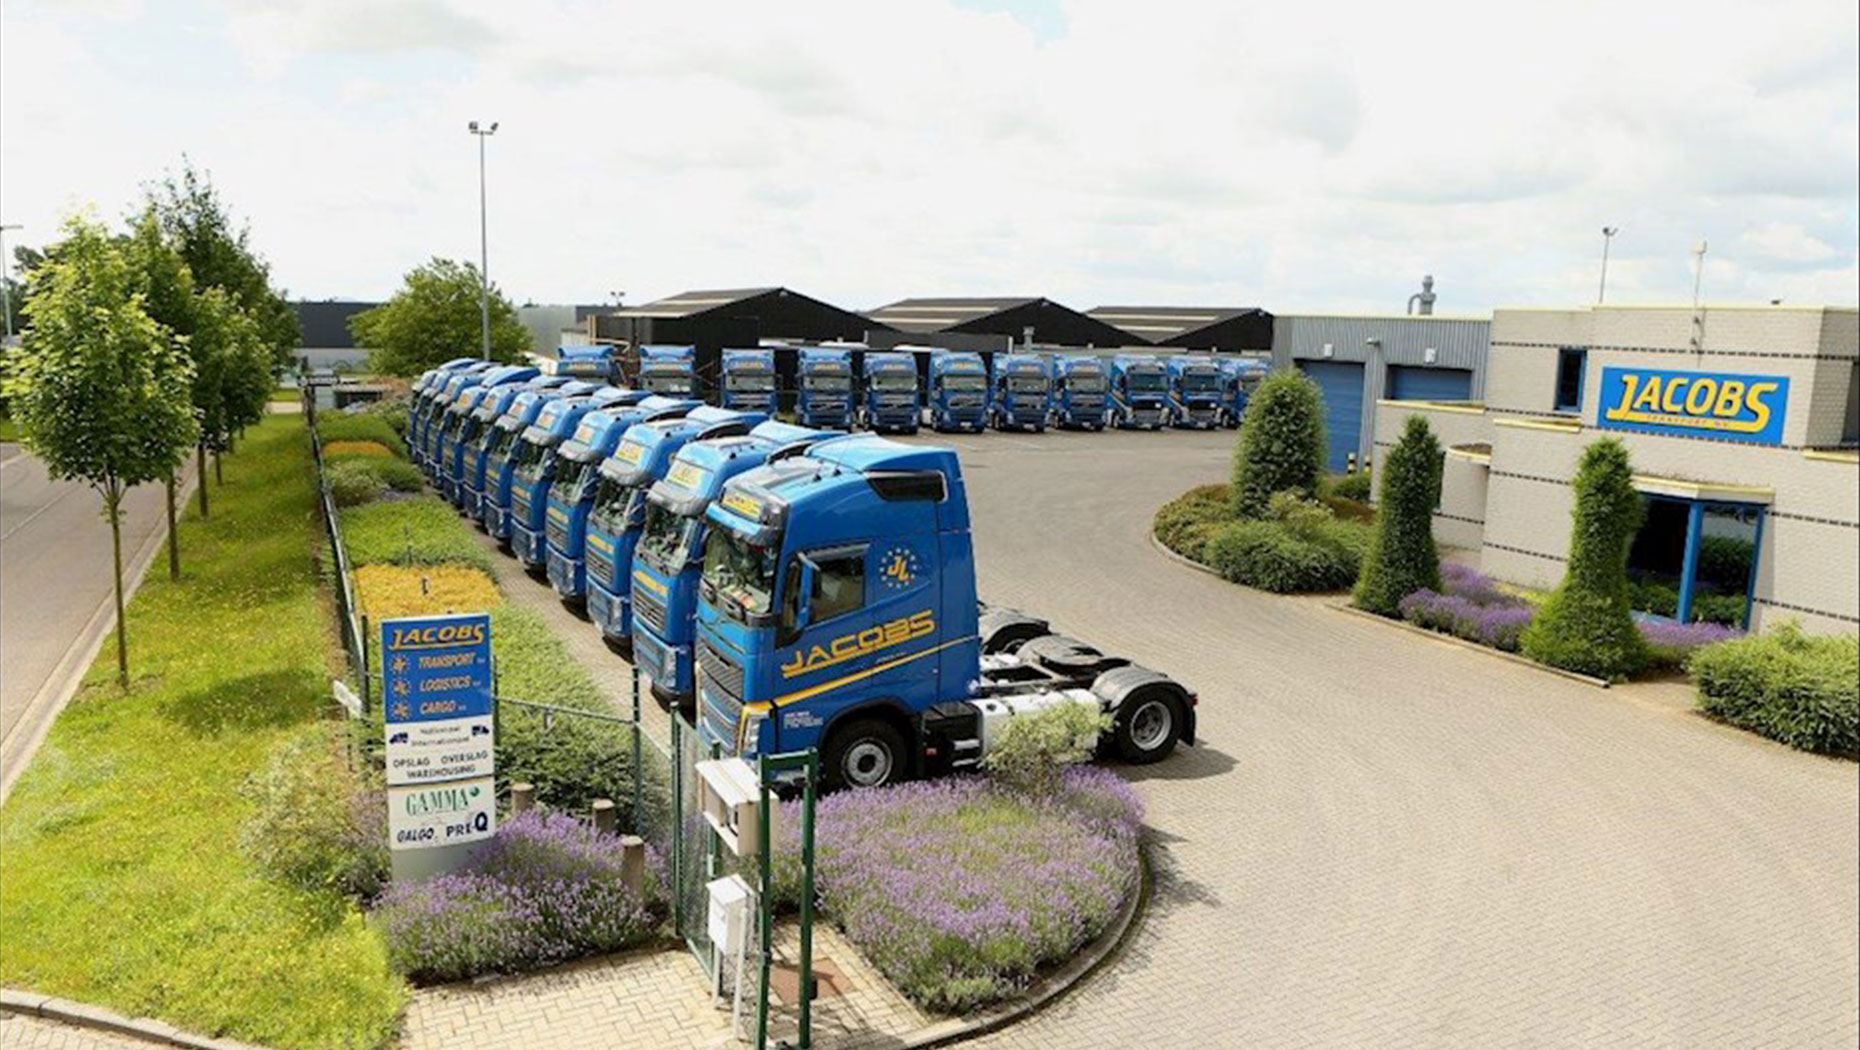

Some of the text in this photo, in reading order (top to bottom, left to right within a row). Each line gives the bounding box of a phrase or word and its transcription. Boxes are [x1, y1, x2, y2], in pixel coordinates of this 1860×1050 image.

[1606, 374, 1778, 434] JACOBS
[388, 623, 486, 651] JACOBS
[781, 610, 936, 677] JACOBS
[419, 652, 476, 669] TRANSPORT
[420, 675, 471, 692] LOGISTICS
[421, 700, 456, 714] CARGO
[393, 750, 488, 768] OPSLAG OVERSLAG
[406, 764, 476, 778] WAREHOUSING
[406, 788, 468, 816] GAMMA
[397, 827, 434, 842] GALGO
